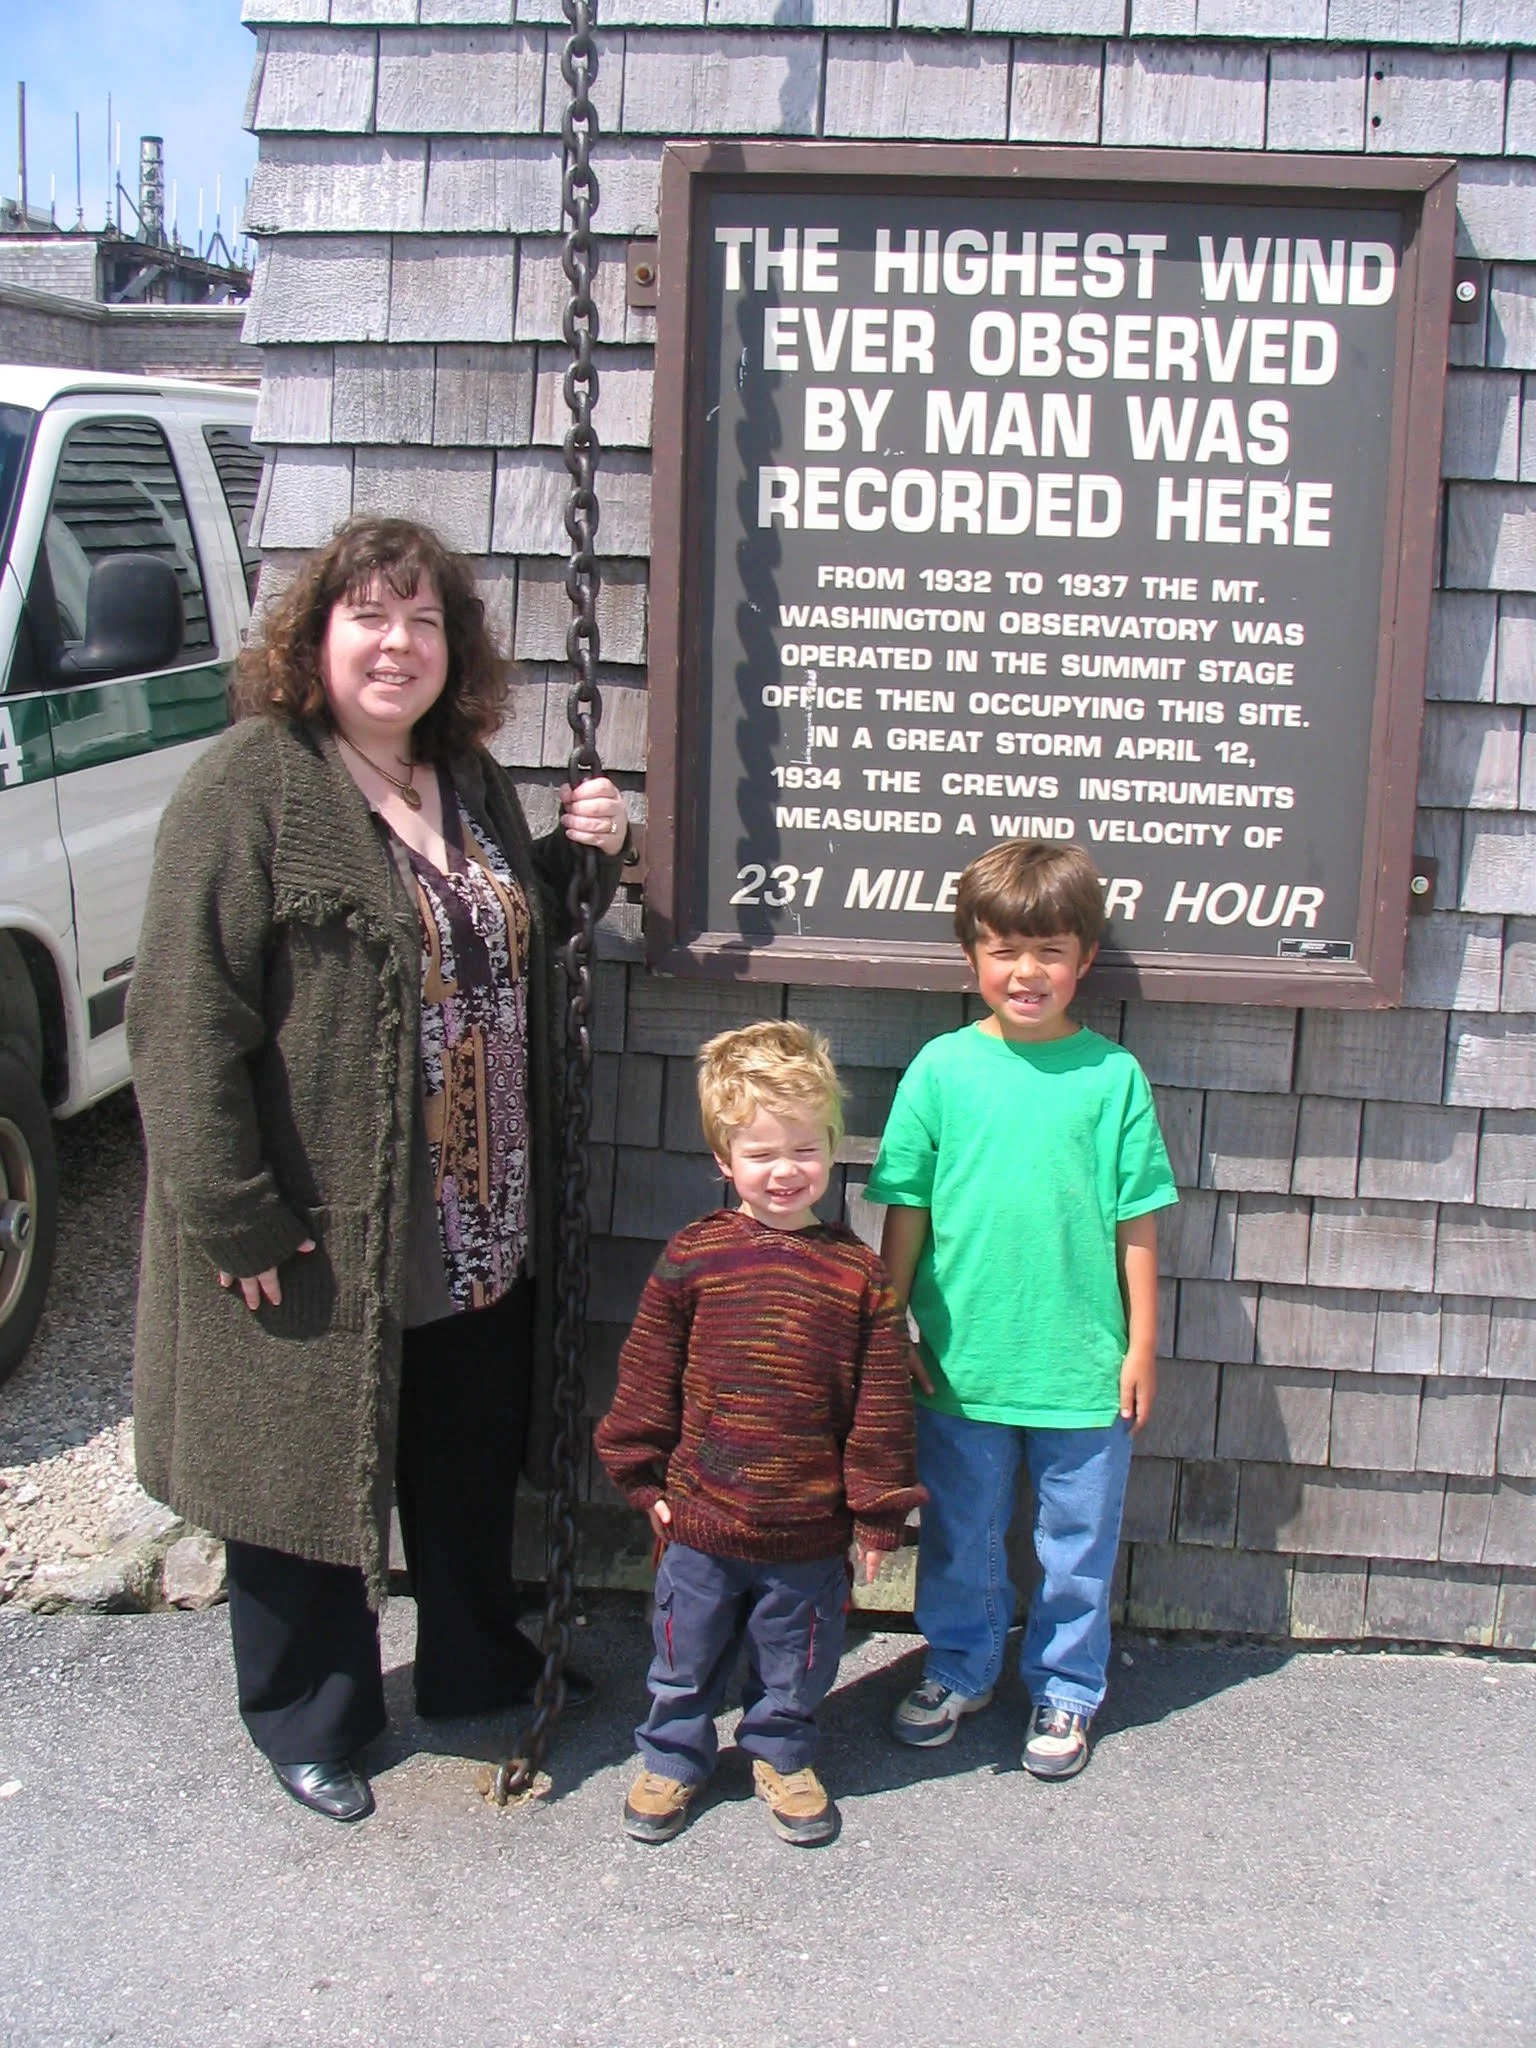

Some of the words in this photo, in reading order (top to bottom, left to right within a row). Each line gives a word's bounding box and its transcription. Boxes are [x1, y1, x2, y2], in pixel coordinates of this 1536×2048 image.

[715, 227, 840, 293] THE
[873, 229, 1168, 300] HIGHEST
[1198, 236, 1396, 307] WIND
[763, 307, 936, 375] EVER
[967, 310, 1340, 387] OBSERVED
[803, 387, 894, 453] BY
[923, 389, 1093, 459] MAN
[1126, 395, 1291, 465] WAS
[758, 465, 1123, 538] RECORDED
[1156, 473, 1333, 547] HERE
[817, 565, 905, 591] FROM
[919, 568, 992, 593] 1932
[1005, 571, 1044, 595] TO
[1057, 573, 1129, 598] 1937
[1141, 576, 1198, 601] THE
[1211, 579, 1265, 604] MT.
[779, 605, 986, 633] WASHINGTON
[999, 611, 1218, 642] OBSERVATORY
[1231, 620, 1304, 646] WAS
[780, 643, 933, 672] OPERATED
[946, 649, 978, 673] IN
[991, 650, 1047, 675] THE
[1061, 653, 1186, 681] SUMMIT
[1198, 659, 1294, 686] STAGE
[761, 684, 863, 711] OFFICE
[875, 688, 955, 713] THEN
[968, 691, 1145, 721] OCCUPYING
[1157, 699, 1225, 724] THIS
[1238, 702, 1309, 728] SITE.
[810, 726, 839, 749] IN
[851, 727, 873, 749] A
[886, 727, 984, 753] GREAT
[995, 731, 1102, 758] STORM
[1114, 736, 1201, 762] APRIL
[1214, 741, 1256, 768] 12,
[770, 767, 841, 791] 1934
[862, 769, 921, 794] THE
[941, 772, 1059, 799] CREWS
[1079, 777, 1294, 809] INSTRUMENTS
[776, 806, 942, 834] MEASURED
[955, 813, 977, 836] A
[990, 814, 1075, 840] WIND
[1088, 818, 1231, 847] VELOCITY
[1244, 826, 1283, 849] OF
[730, 864, 824, 907] 231
[843, 868, 961, 913] MILE
[1164, 881, 1325, 928] HOUR
